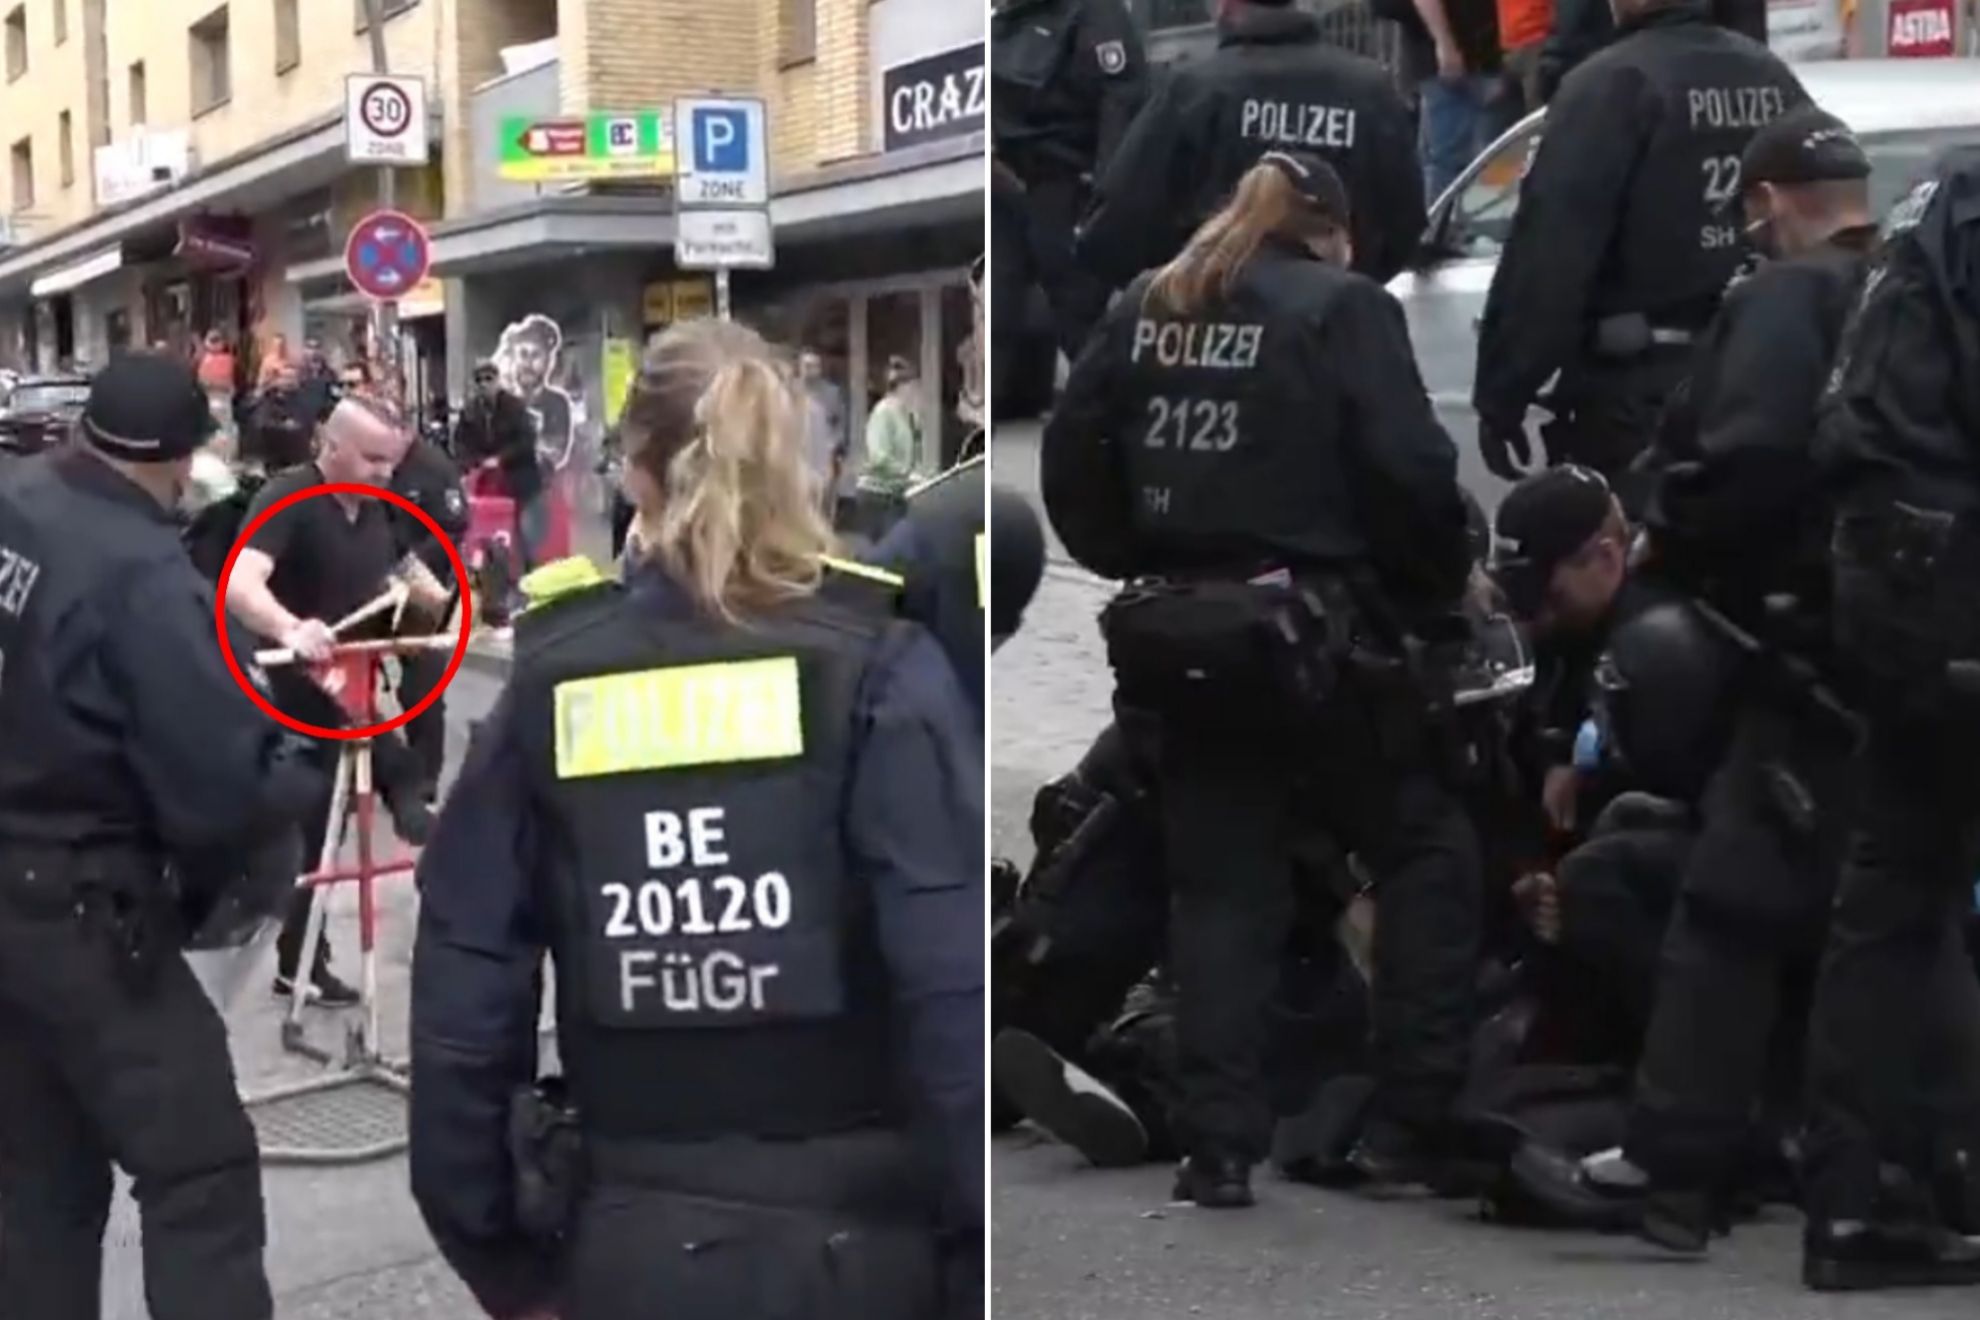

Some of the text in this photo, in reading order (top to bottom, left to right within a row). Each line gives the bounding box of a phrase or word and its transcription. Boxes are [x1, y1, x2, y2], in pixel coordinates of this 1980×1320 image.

[371, 96, 402, 123] 30
[892, 65, 985, 133] CRAZ
[1241, 100, 1356, 147] POLIZEI
[1688, 86, 1784, 129] POLIZEI
[705, 116, 735, 164] P
[699, 180, 745, 199] ZONE
[1701, 224, 1735, 248] SH
[1131, 318, 1264, 368] POLIZEI
[1144, 396, 1239, 450] 2123
[644, 807, 729, 869] BE
[601, 871, 792, 937] 20120
[619, 949, 779, 1012] FüGr
